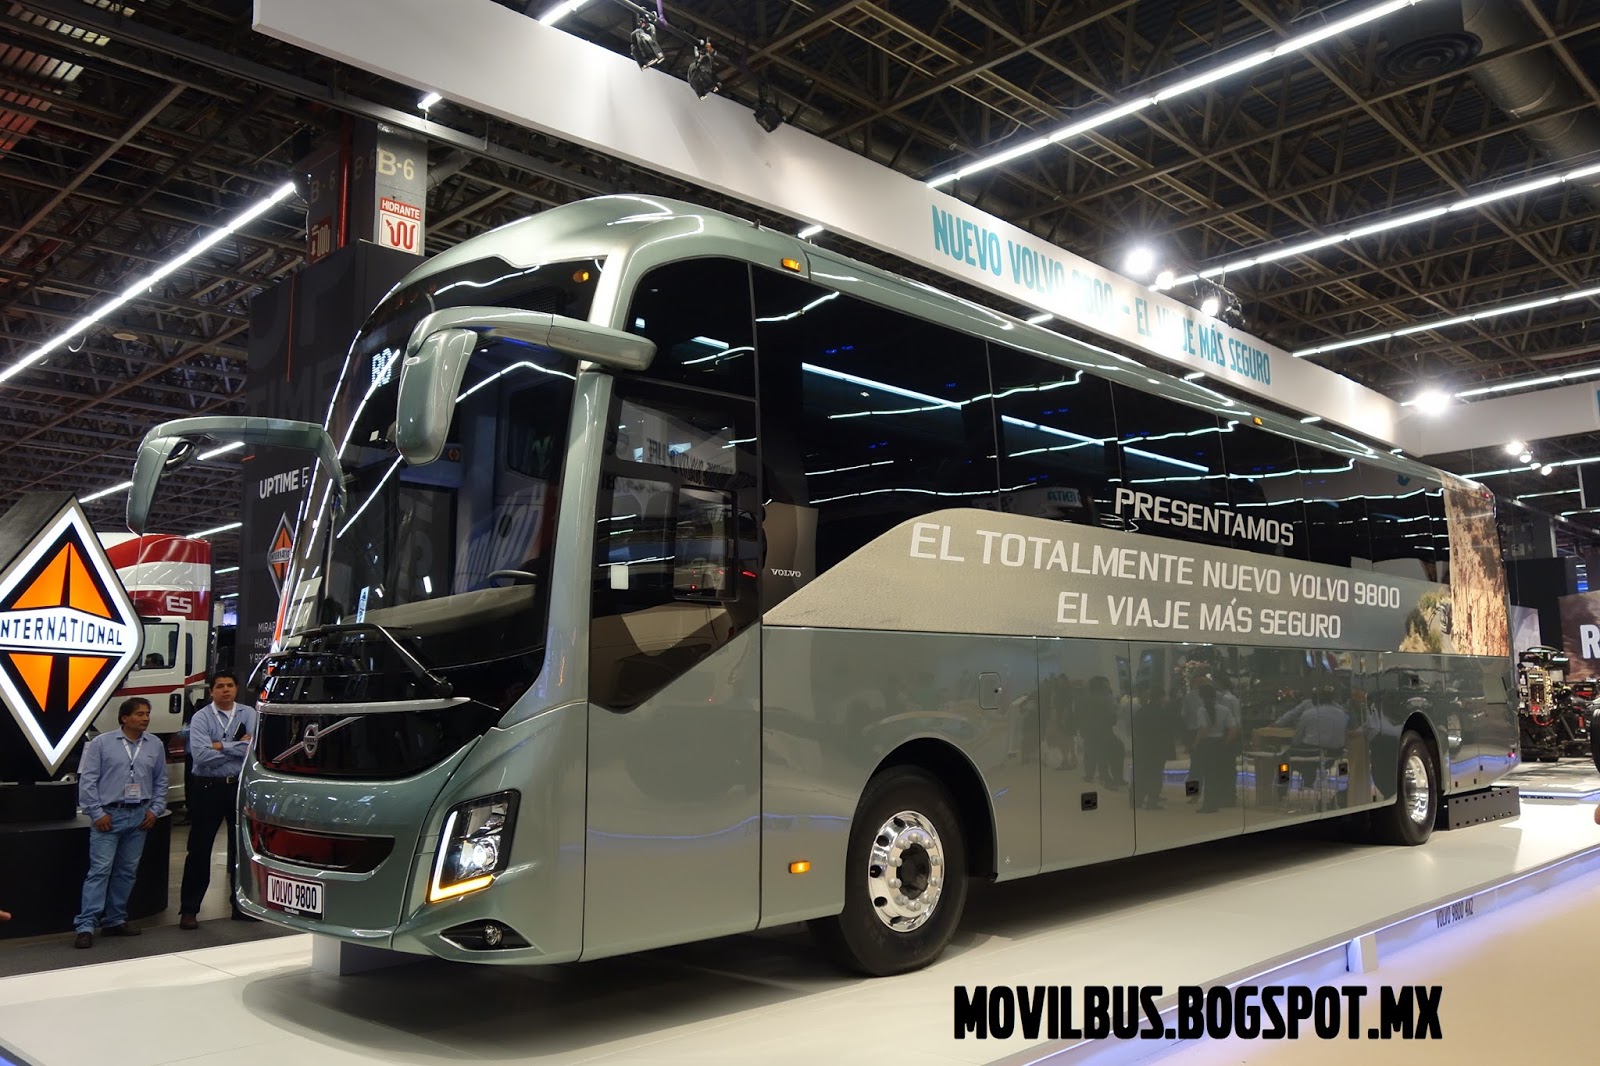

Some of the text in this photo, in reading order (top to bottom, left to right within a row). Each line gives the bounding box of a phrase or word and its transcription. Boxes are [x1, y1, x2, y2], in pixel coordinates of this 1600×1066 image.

[382, 200, 420, 219] HIDRANTE
[932, 204, 1002, 277] NUEVO
[1008, 239, 1065, 296] VOLVO
[1135, 296, 1152, 337] EL
[1198, 323, 1226, 368] MÁS
[1228, 337, 1272, 386] SEGURO
[259, 469, 300, 499] UPTIME
[1114, 487, 1294, 546] PRESENTAMOS
[771, 568, 801, 577] VOLVO
[910, 522, 1400, 609] EL TOTALMENTE NUEVO VOLVO 9800
[165, 595, 193, 613] ES
[1056, 591, 1341, 639] EL VIAJE MÁS SEGURO
[271, 878, 316, 910] VOLVO 9800
[1435, 905, 1451, 928] VOLVO
[1452, 900, 1464, 922] 9800
